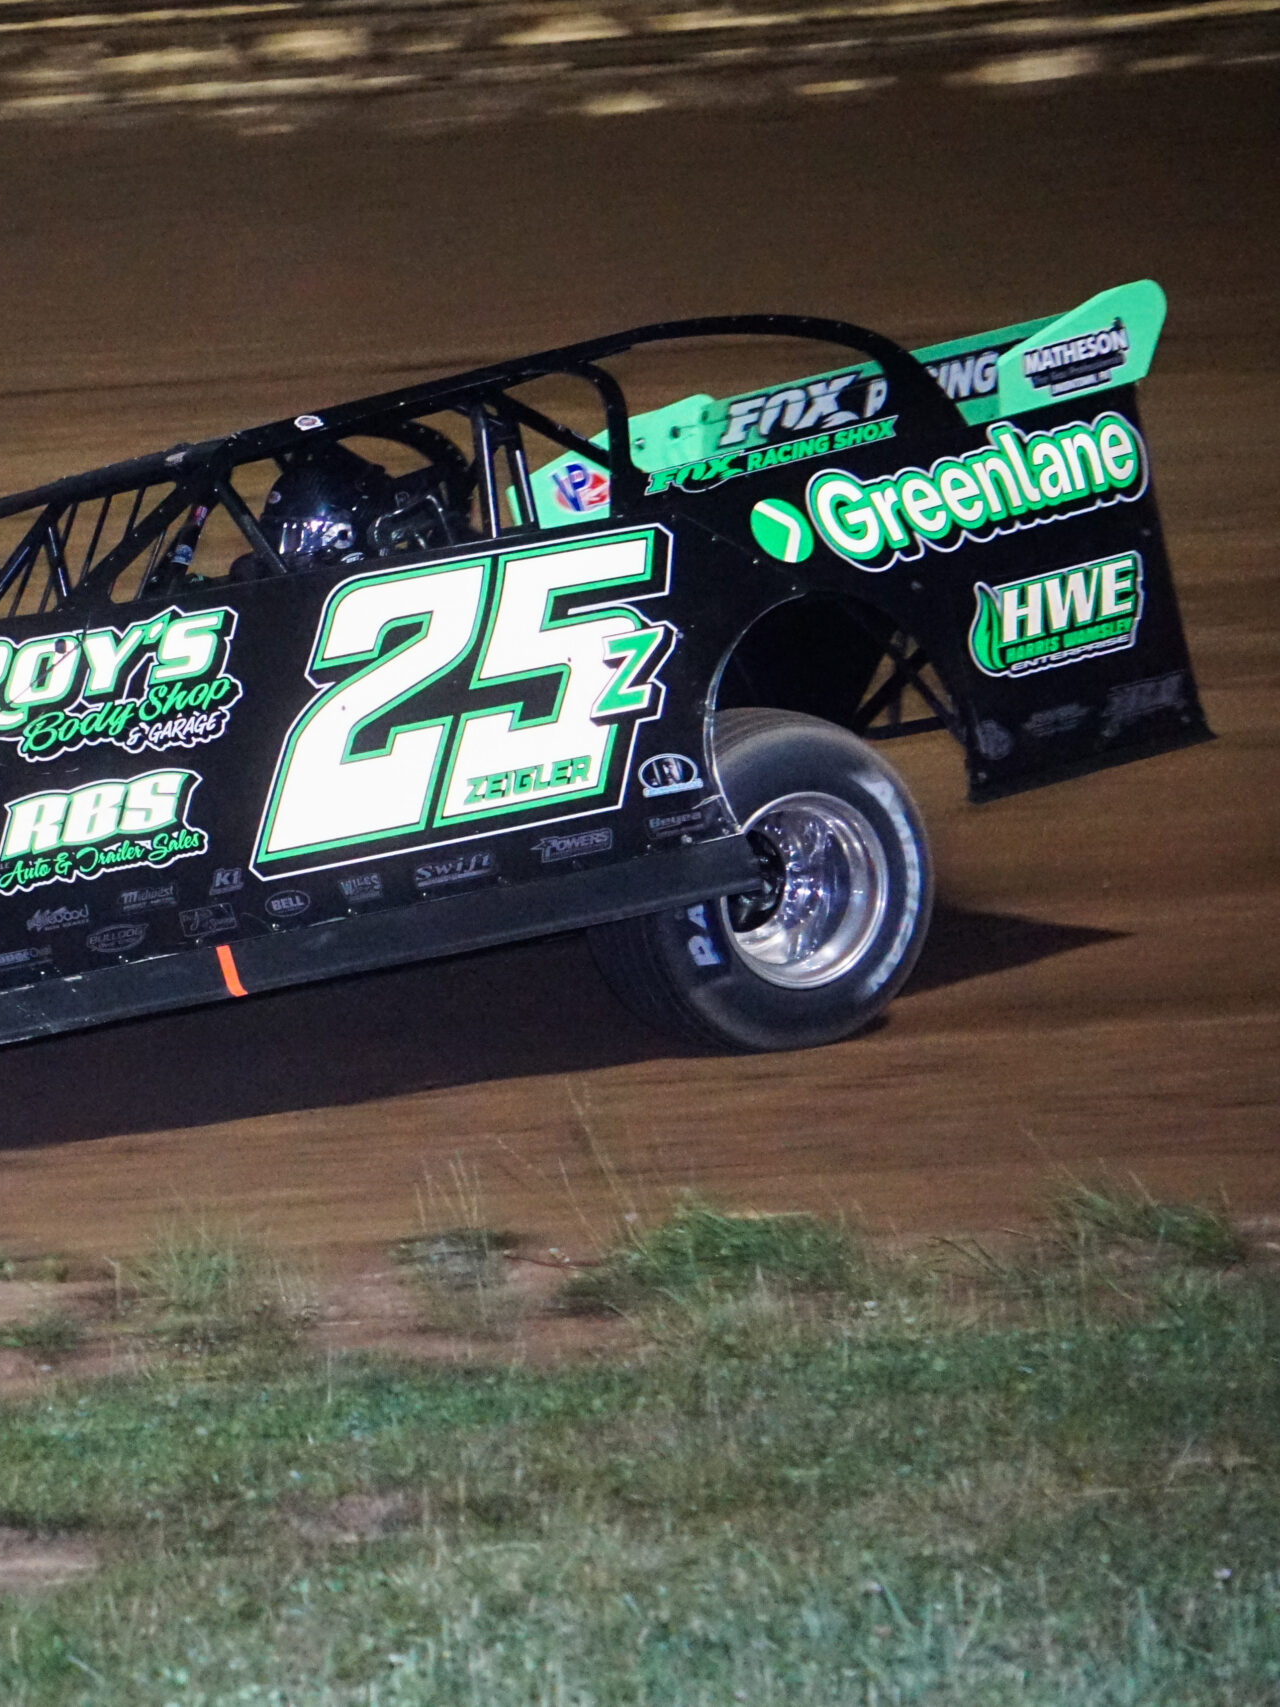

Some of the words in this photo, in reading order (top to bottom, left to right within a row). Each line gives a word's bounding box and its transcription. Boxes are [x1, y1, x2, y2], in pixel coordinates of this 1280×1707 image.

[1024, 326, 1129, 376] MATHESON
[719, 371, 861, 447] FOX
[863, 356, 999, 418] RING
[647, 450, 744, 494] FOX
[747, 435, 831, 470] RACING
[833, 416, 895, 448] SHOX
[551, 463, 592, 512] VP
[812, 416, 1138, 561] Greenlane
[1001, 554, 1135, 644] HWE
[1005, 635, 1060, 665] HARRIS
[1010, 634, 1131, 671] ENTERPRISE
[22, 702, 139, 753] Body
[138, 677, 232, 722] Shop
[257, 530, 654, 863] 25
[126, 726, 142, 746] &
[148, 711, 222, 744] GARAGE
[463, 754, 592, 806] ZEIGLER
[1, 772, 194, 861] RBS
[54, 852, 73, 876] &
[76, 840, 145, 873] Trailer
[147, 832, 201, 862] Sales
[415, 852, 492, 879] Swift
[271, 895, 305, 911] BELL
